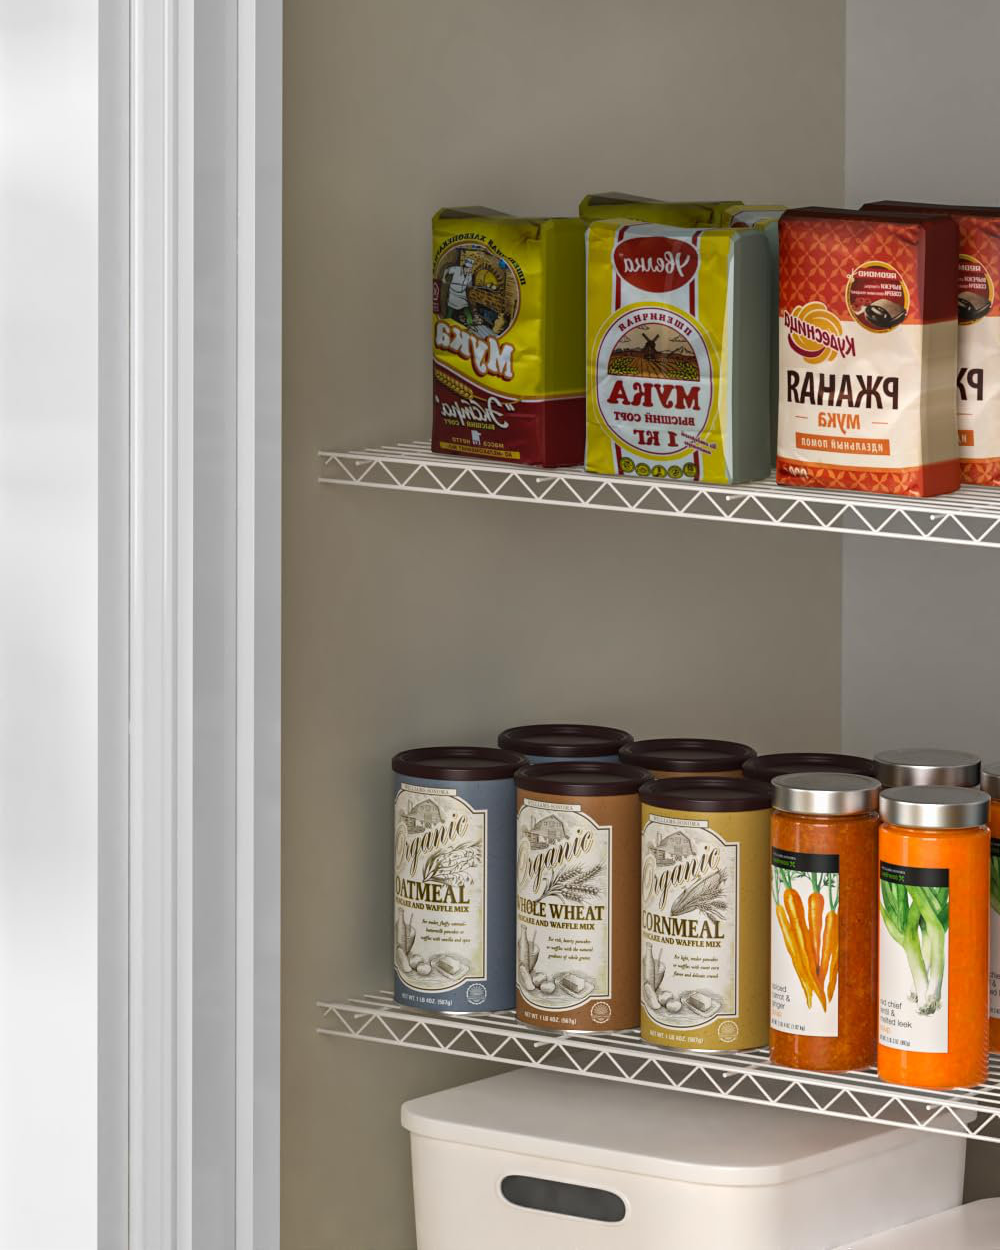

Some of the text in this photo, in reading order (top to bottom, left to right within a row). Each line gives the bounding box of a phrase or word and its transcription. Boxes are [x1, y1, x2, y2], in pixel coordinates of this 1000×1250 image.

[395, 876, 470, 904] OATMEAL
[412, 902, 469, 913] AND WAFFLE MIX
[549, 903, 605, 921] WHEAT
[535, 919, 549, 927] AND
[550, 921, 578, 930] WAFFLE
[642, 910, 725, 939] CORNMEAL
[661, 937, 721, 948] AND WAFFLE MIX
[897, 1020, 912, 1028] leek
